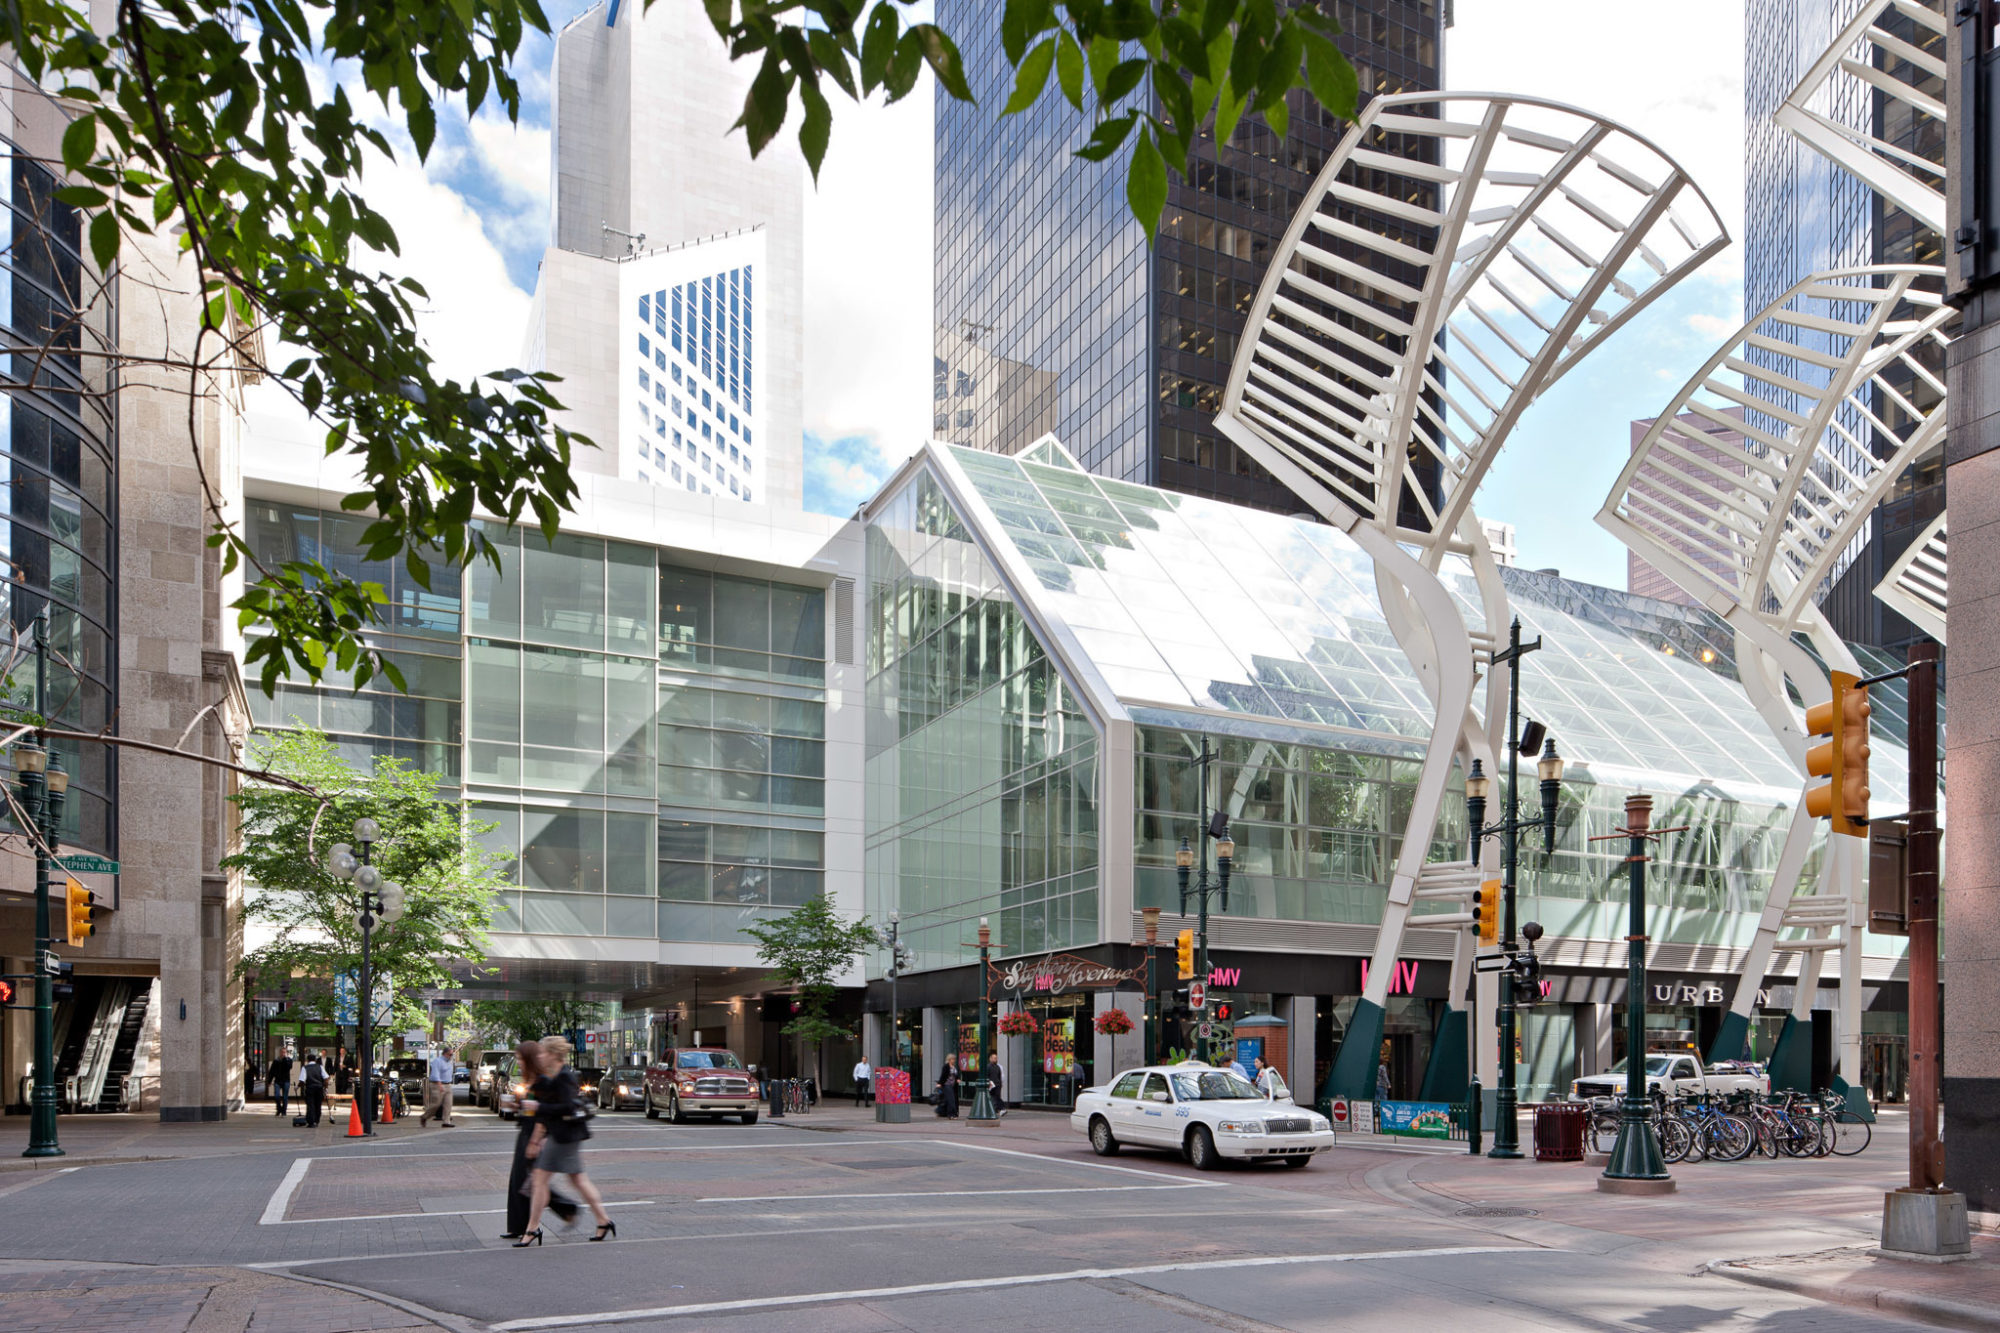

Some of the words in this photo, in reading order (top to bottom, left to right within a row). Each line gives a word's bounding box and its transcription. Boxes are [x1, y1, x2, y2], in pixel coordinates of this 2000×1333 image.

[98, 863, 113, 872] AVE
[1003, 951, 1072, 993] Stephen
[1050, 962, 1133, 994] Avenue
[1208, 967, 1241, 986] HMV
[1654, 984, 1771, 1004] URBN
[959, 1027, 976, 1040] HOT
[1045, 1022, 1066, 1036] HOT
[959, 1039, 980, 1053] deal
[1045, 1036, 1075, 1053] deals
